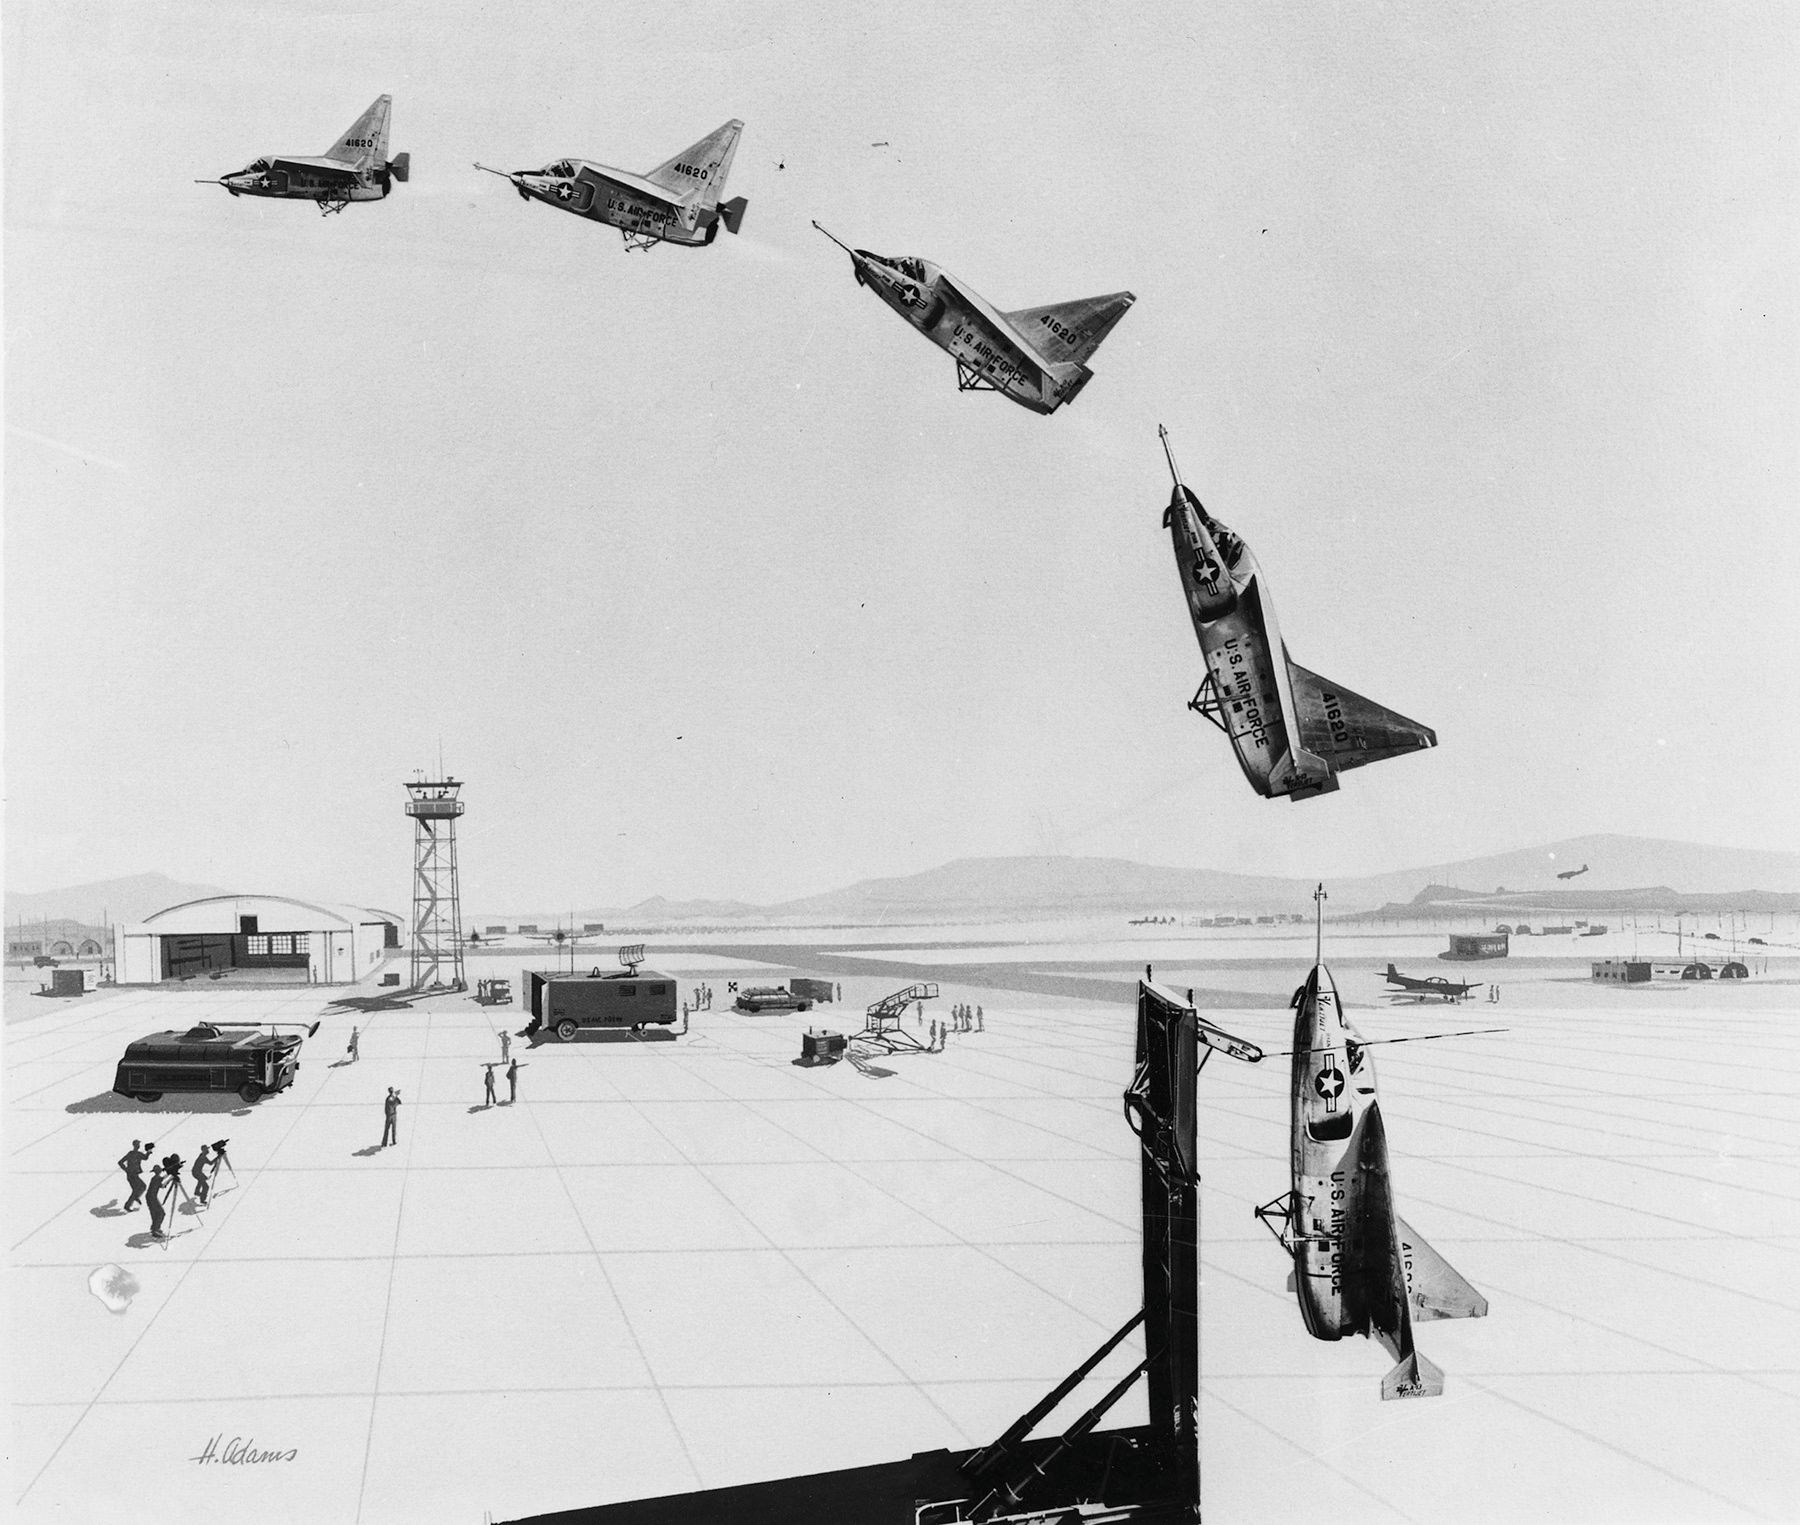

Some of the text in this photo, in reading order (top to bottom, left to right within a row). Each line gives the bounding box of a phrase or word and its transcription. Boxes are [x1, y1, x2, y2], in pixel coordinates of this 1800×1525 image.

[345, 139, 373, 148] 41620
[674, 162, 708, 180] 41620
[607, 199, 679, 228] U.S. AIR FORCE
[1040, 314, 1077, 345] 41620
[953, 324, 1029, 387] U.S. AIR FORCE
[1224, 638, 1270, 749] U.S. AIR FORCE
[1322, 692, 1349, 743] 41620
[1331, 1171, 1345, 1297] U.S. AIR FORCE
